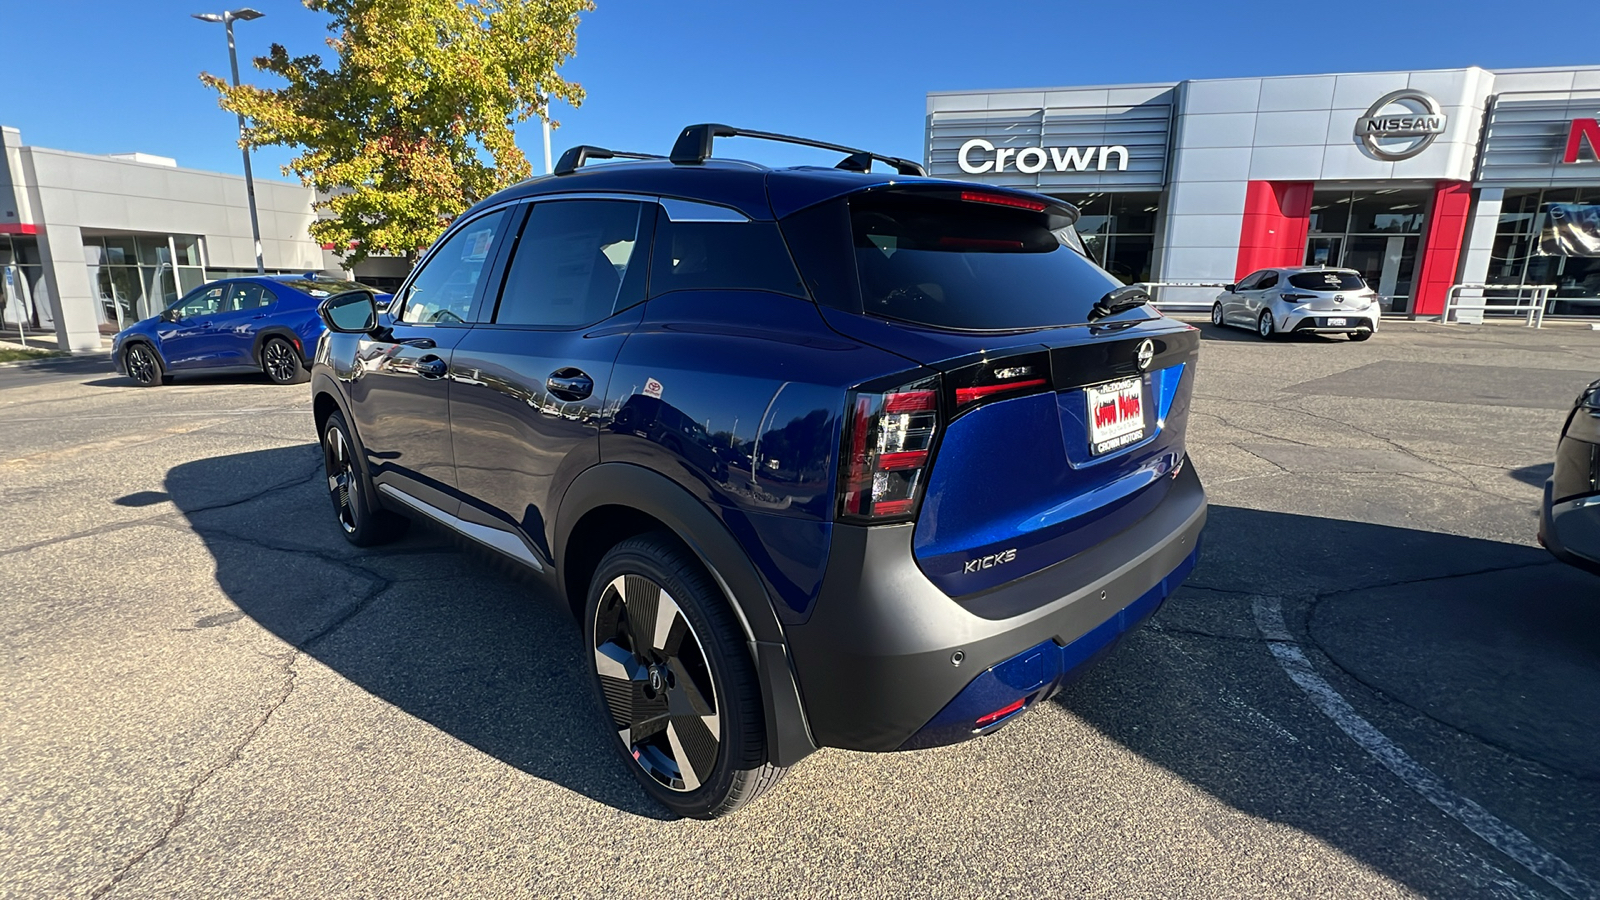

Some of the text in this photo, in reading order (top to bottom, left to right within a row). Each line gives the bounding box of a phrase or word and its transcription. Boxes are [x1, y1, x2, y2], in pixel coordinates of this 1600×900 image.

[1366, 117, 1440, 132] NISSAN
[957, 138, 1129, 174] Crown
[1098, 431, 1143, 453] CROWN MOTORS
[964, 548, 1017, 574] KICKS
